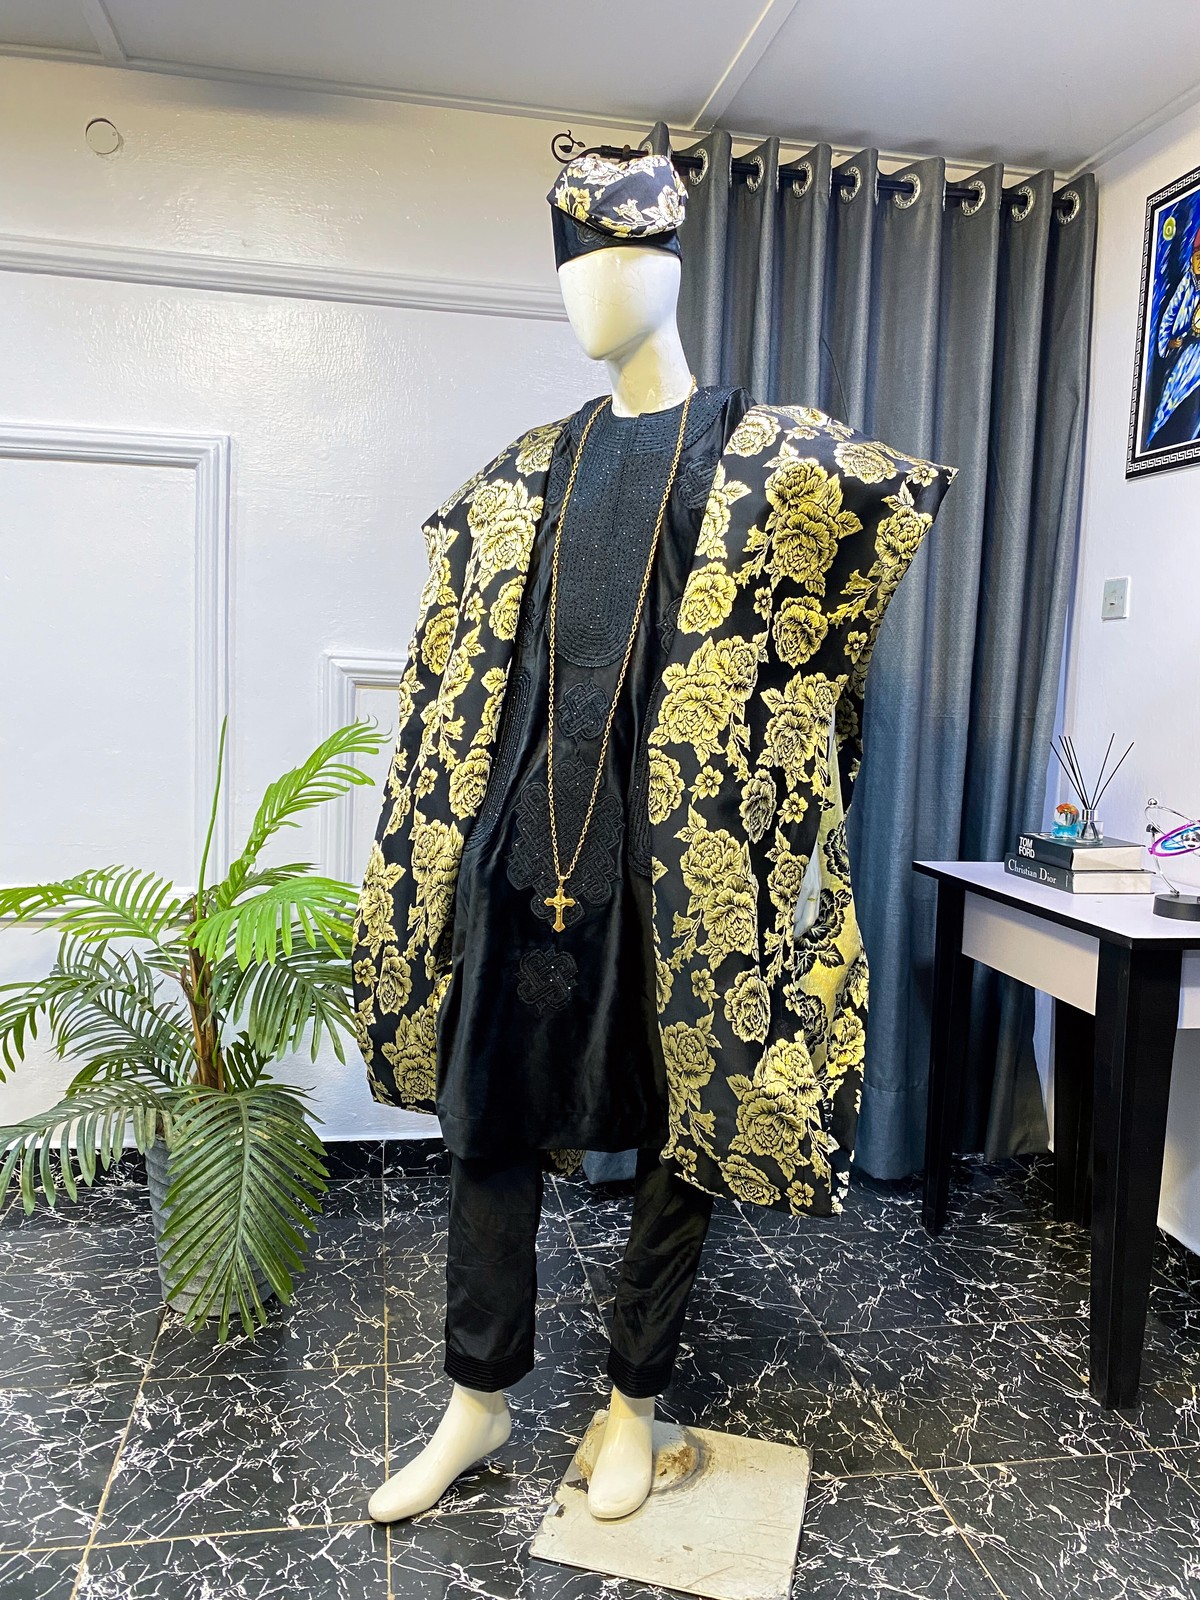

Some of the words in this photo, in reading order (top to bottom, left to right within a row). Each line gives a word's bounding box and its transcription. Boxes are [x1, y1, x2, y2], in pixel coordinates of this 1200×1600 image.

[1019, 836, 1033, 848] TOM
[1018, 846, 1035, 858] FORD
[1008, 858, 1038, 878] Christian
[1039, 867, 1056, 884] Dior
